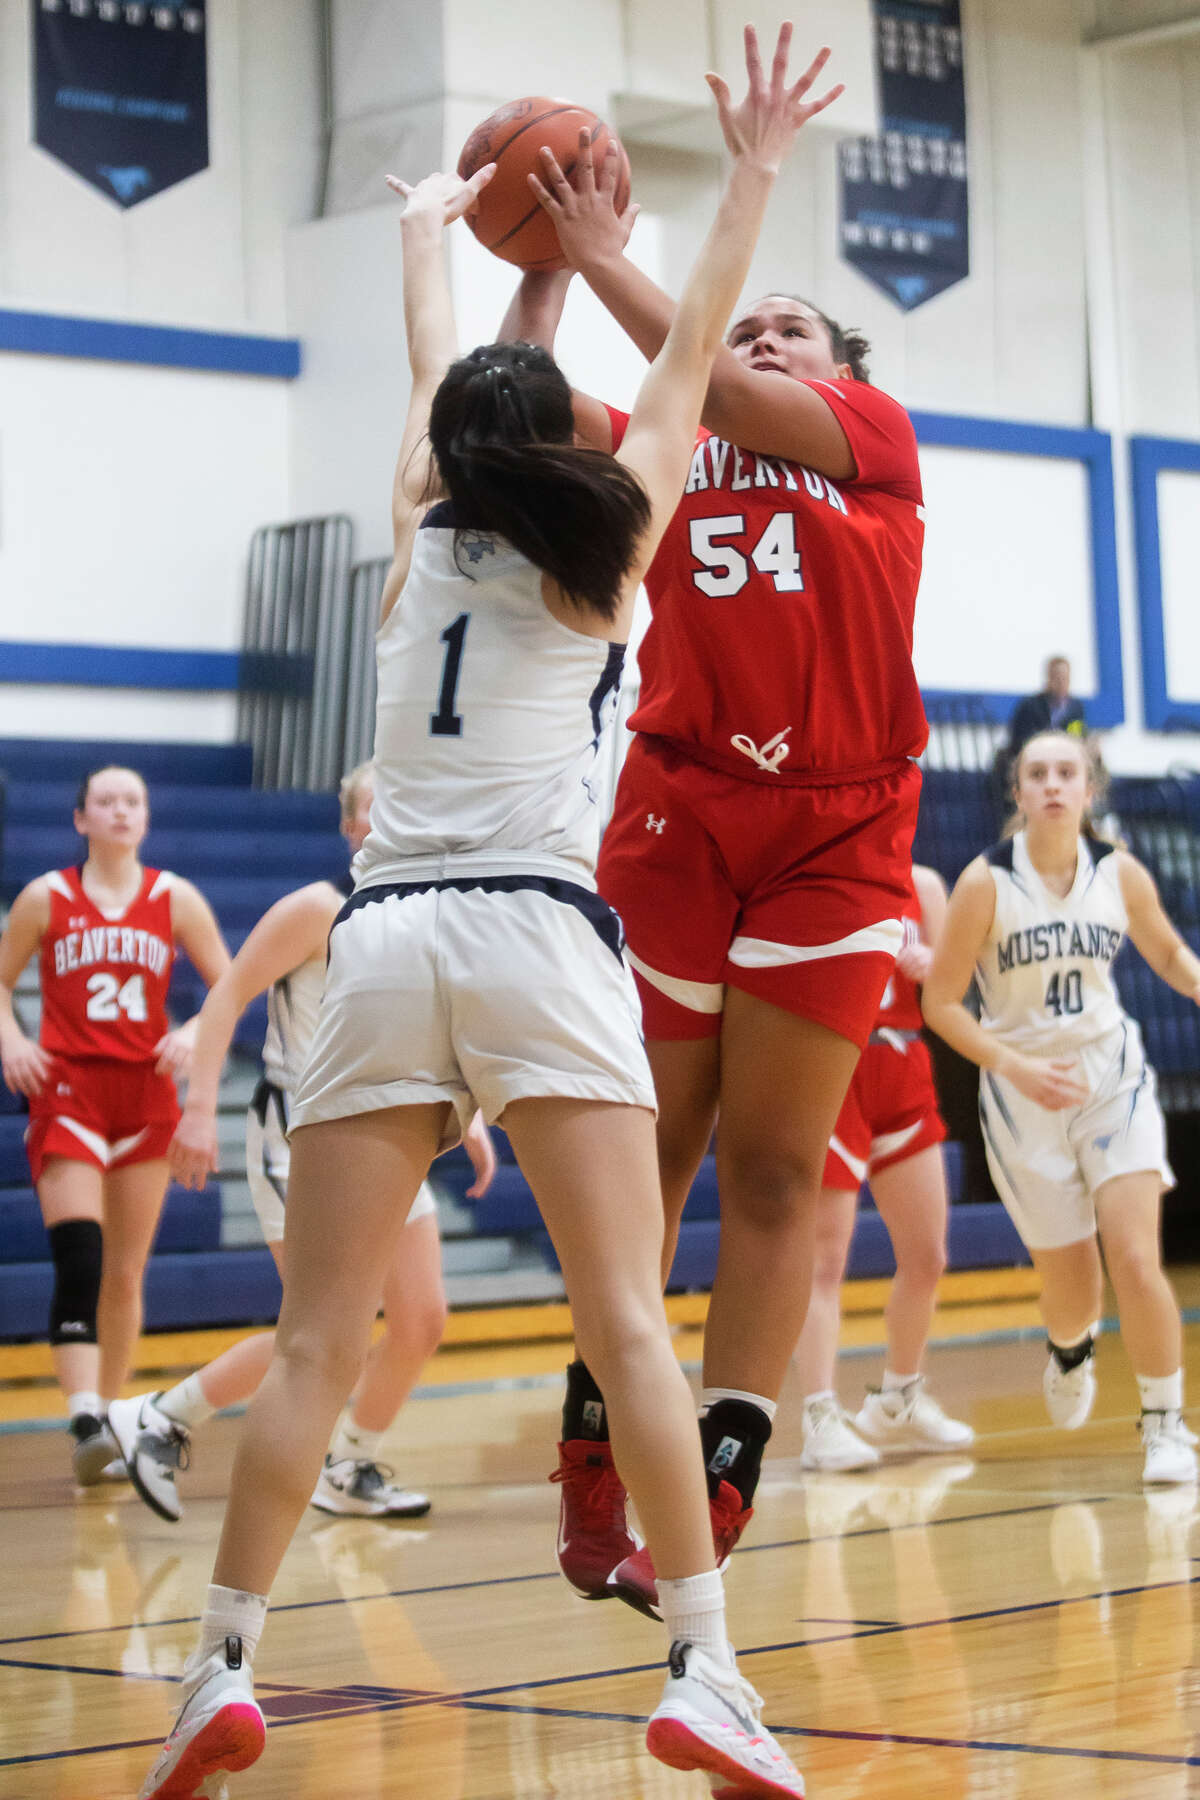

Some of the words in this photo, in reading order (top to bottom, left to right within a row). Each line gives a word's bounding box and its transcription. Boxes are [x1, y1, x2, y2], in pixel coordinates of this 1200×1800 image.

[689, 511, 804, 598] 54
[429, 611, 471, 738] 1
[54, 926, 169, 977] BEAVERTON
[997, 921, 1121, 975] MUSTANGS
[86, 972, 148, 1022] 24
[1045, 969, 1083, 1016] 40
